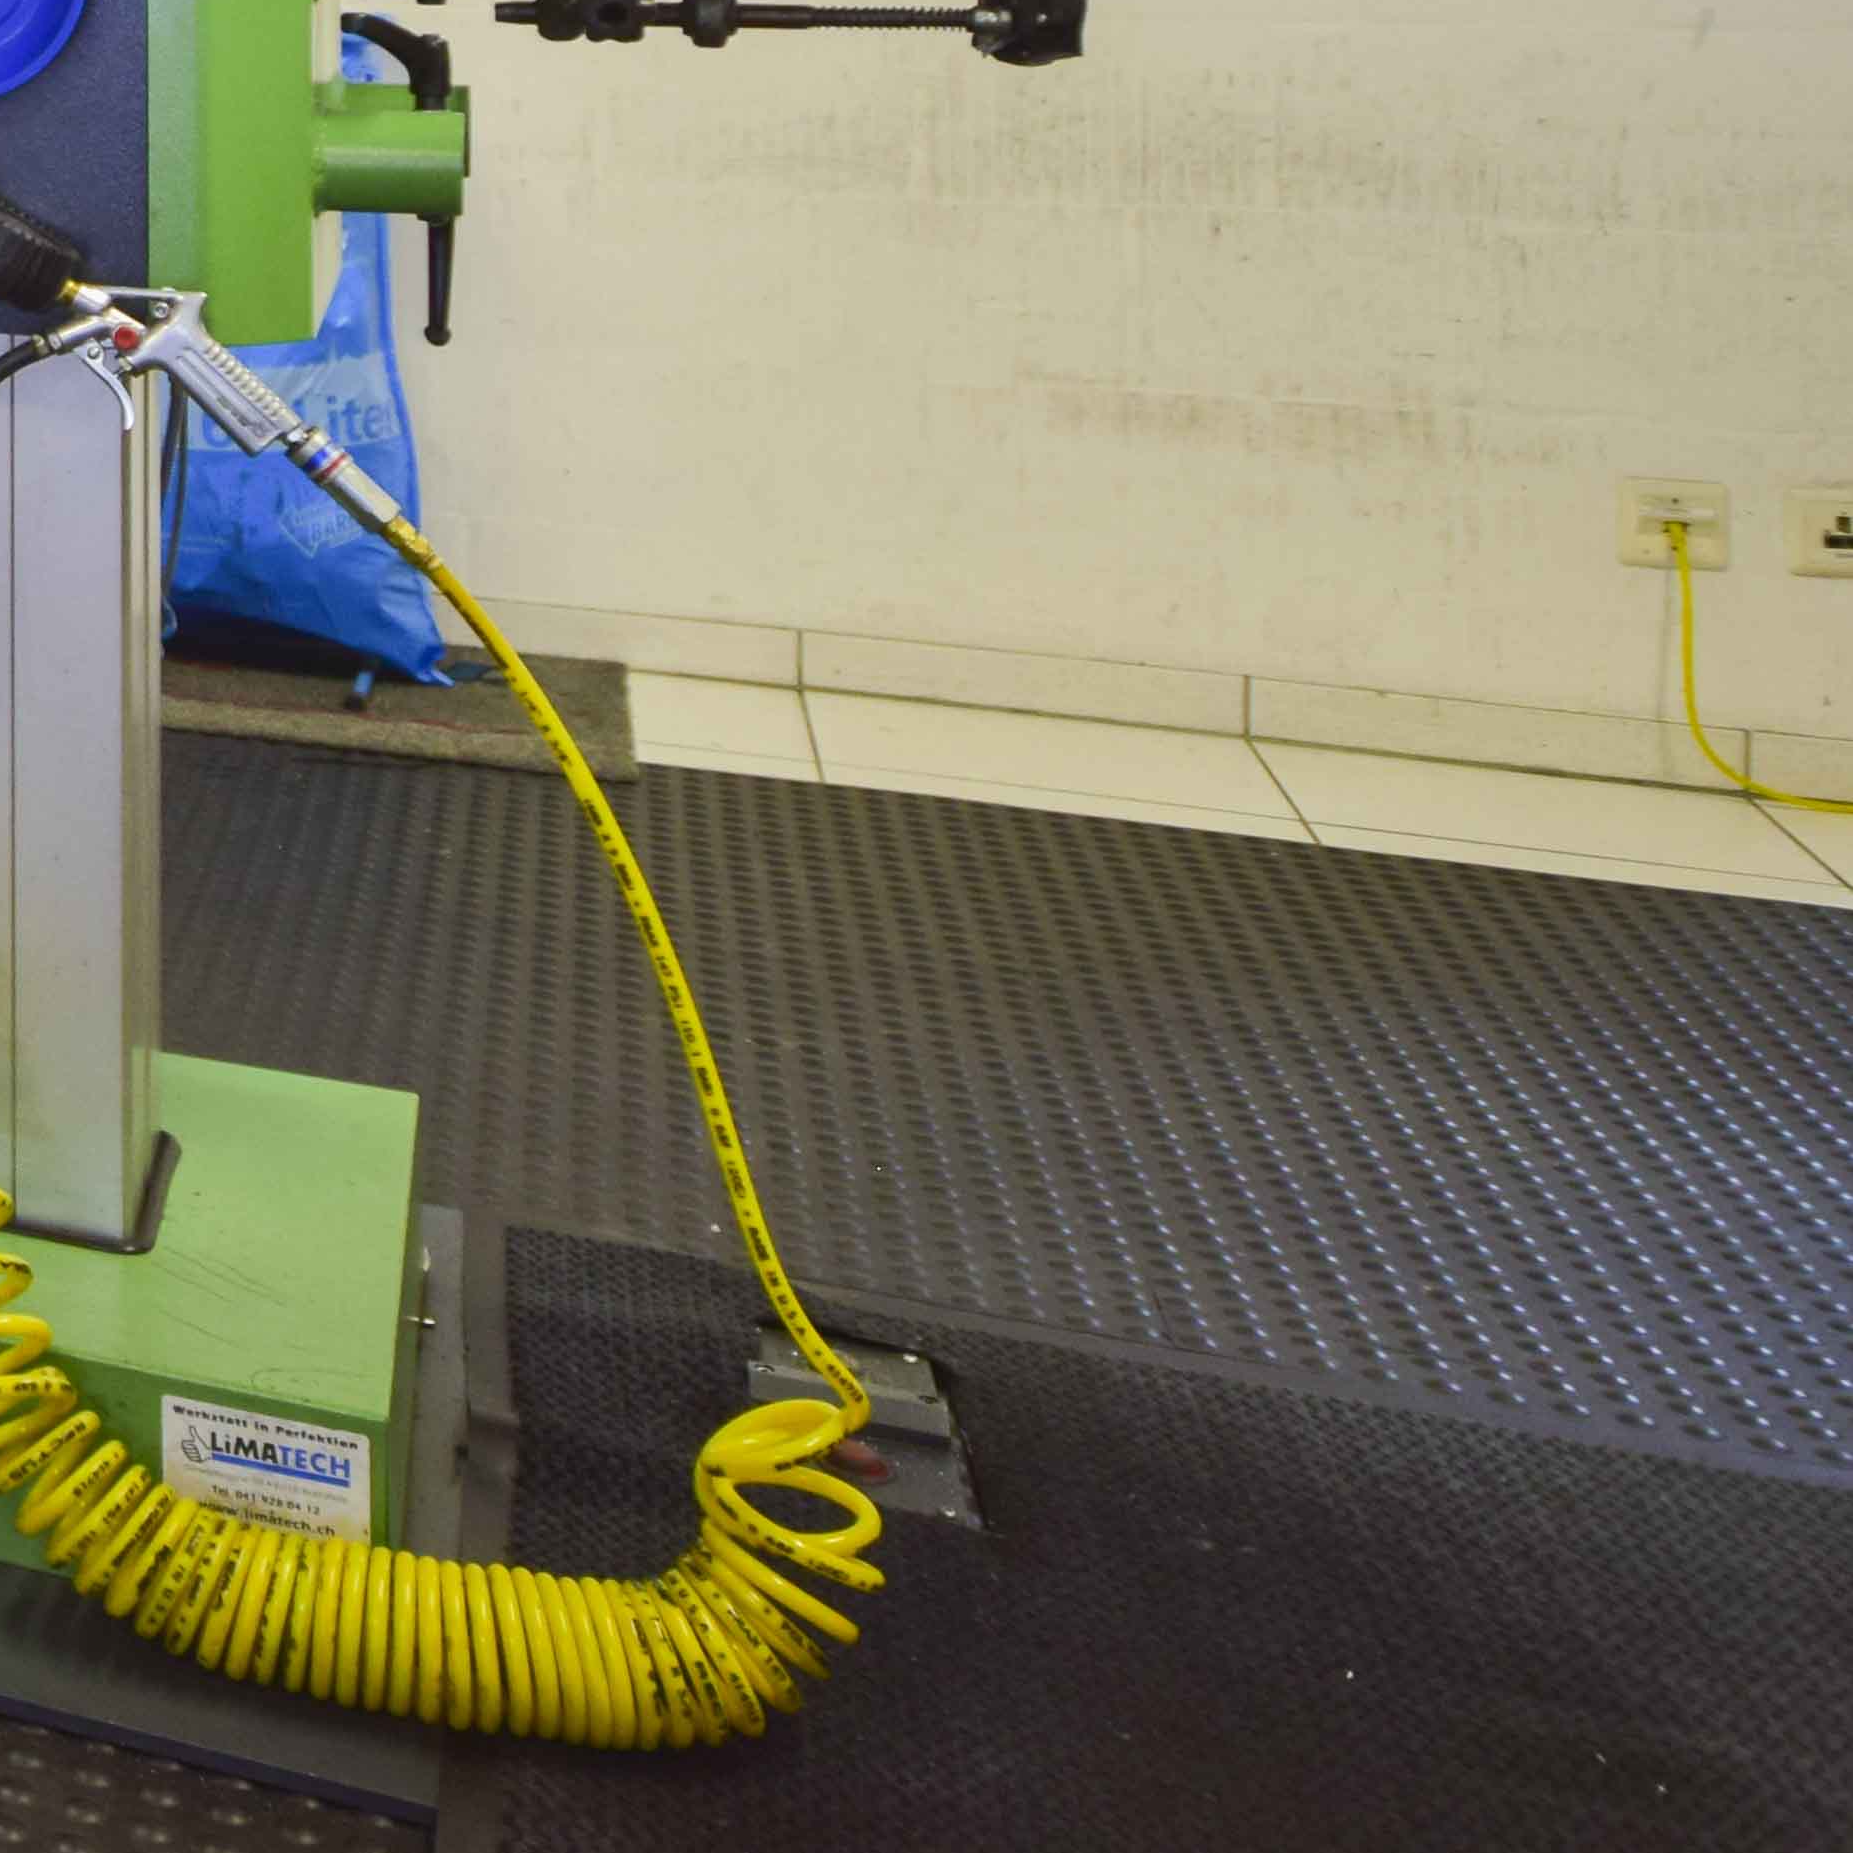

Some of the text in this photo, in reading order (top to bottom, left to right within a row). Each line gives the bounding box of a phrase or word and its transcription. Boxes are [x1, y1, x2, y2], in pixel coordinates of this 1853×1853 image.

[173, 1403, 359, 1451] Werkstatt in Perfektion
[210, 1431, 352, 1479] LiMATECH
